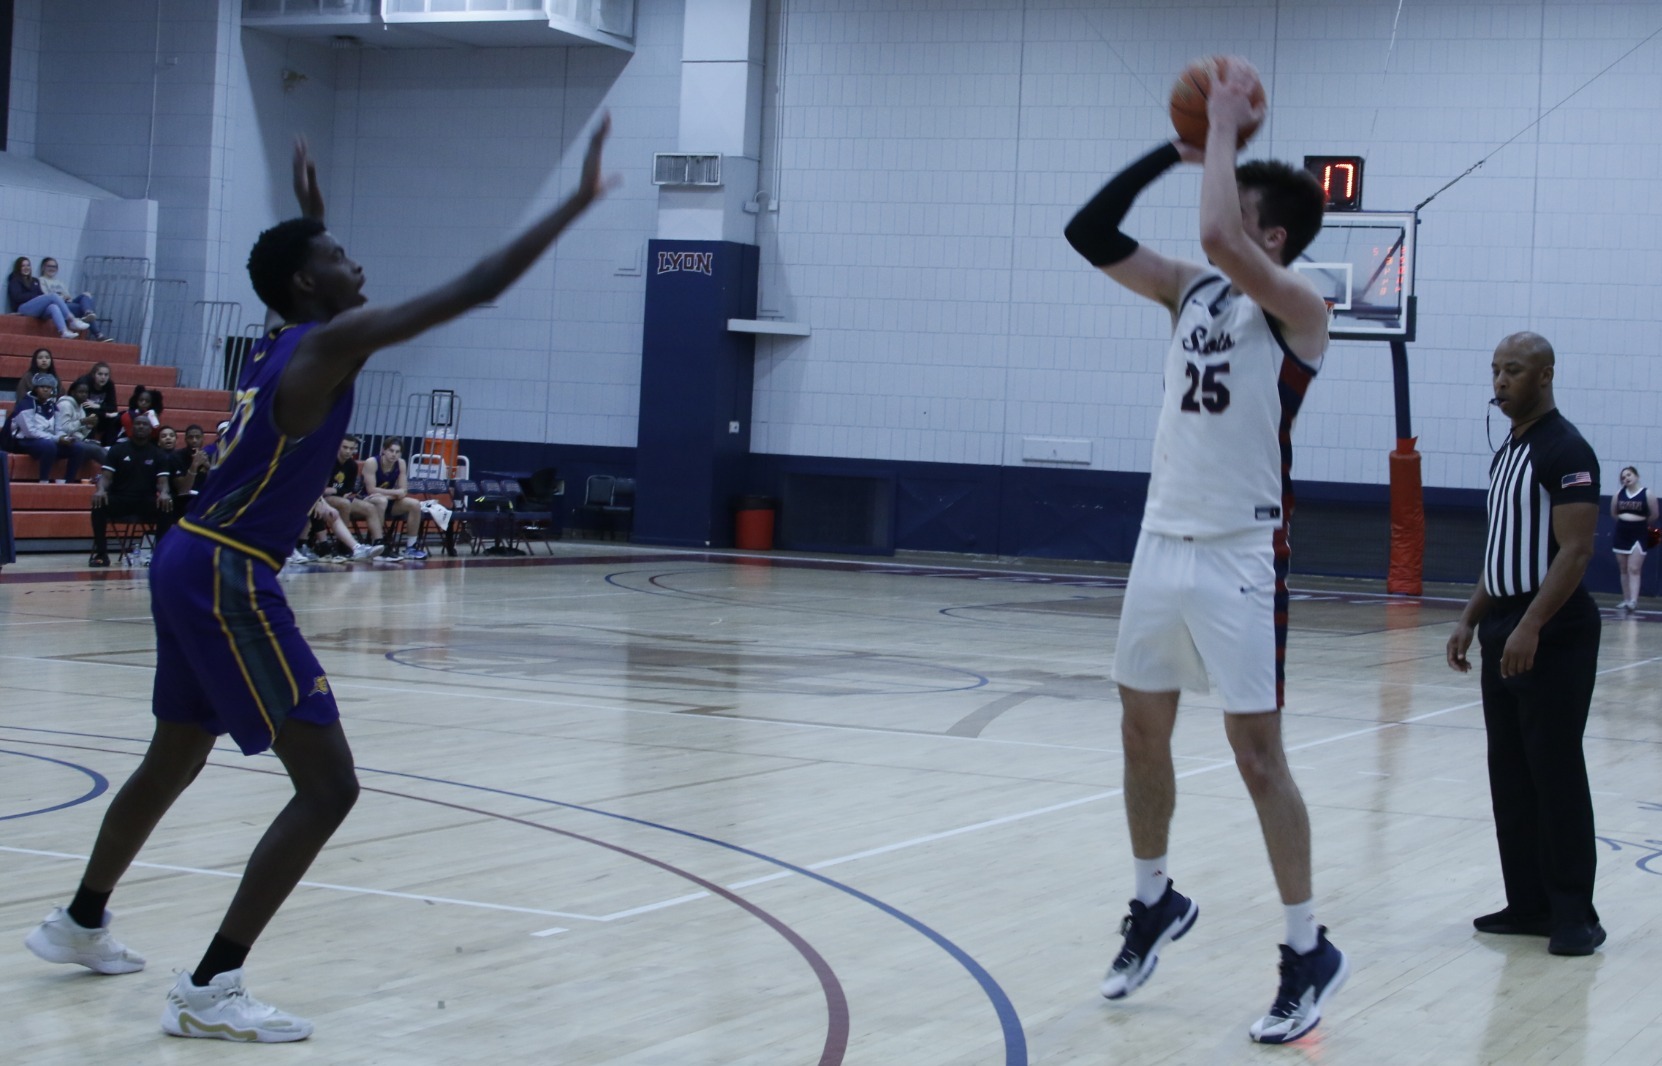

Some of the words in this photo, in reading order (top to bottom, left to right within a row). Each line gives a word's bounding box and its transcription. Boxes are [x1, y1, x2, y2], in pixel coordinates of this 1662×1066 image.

[1323, 162, 1355, 199] 17
[657, 251, 713, 276] LYON
[1180, 361, 1231, 415] 25
